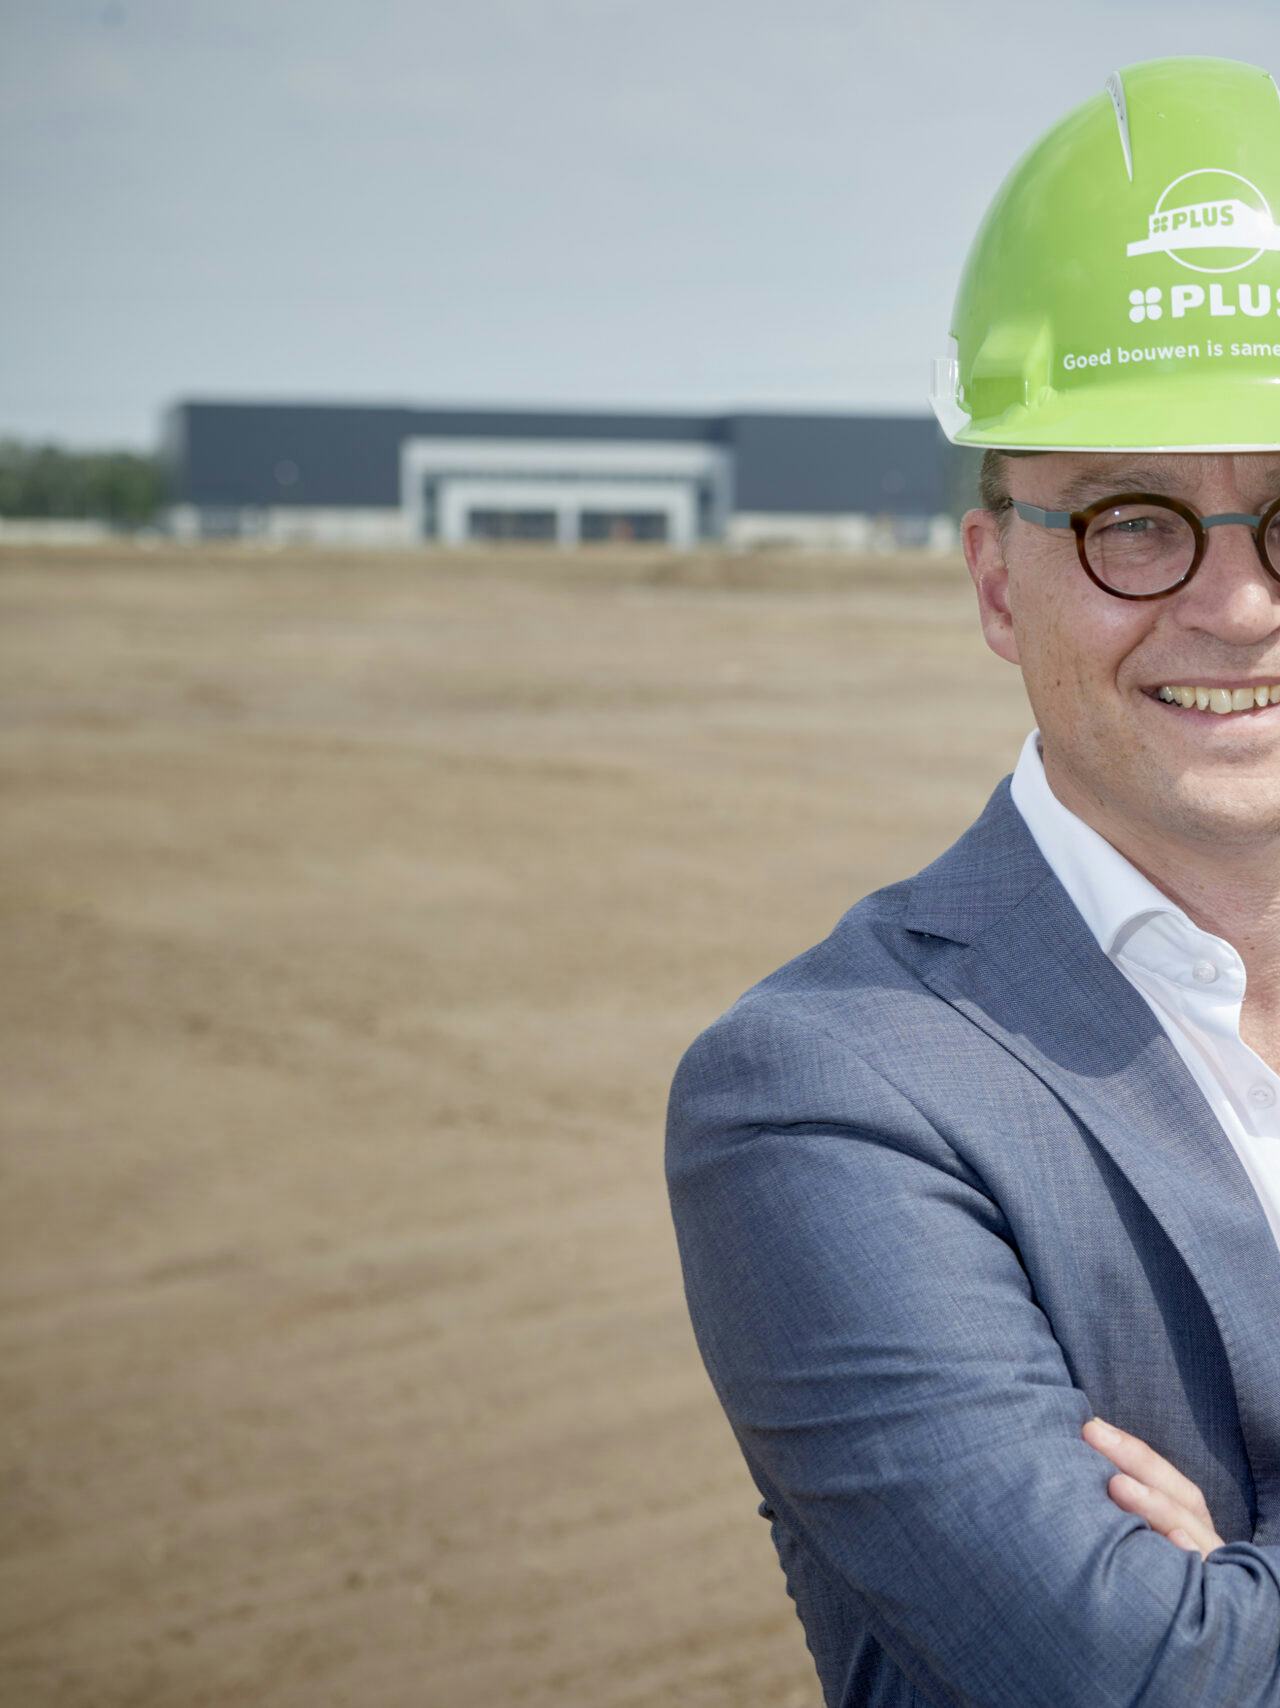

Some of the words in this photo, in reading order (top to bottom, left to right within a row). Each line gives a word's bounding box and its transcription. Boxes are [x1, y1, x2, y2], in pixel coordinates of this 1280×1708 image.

[1172, 205, 1234, 230] PLUS
[1063, 349, 1111, 370] Goed
[1118, 340, 1199, 363] bouwen
[1207, 340, 1223, 356] is
